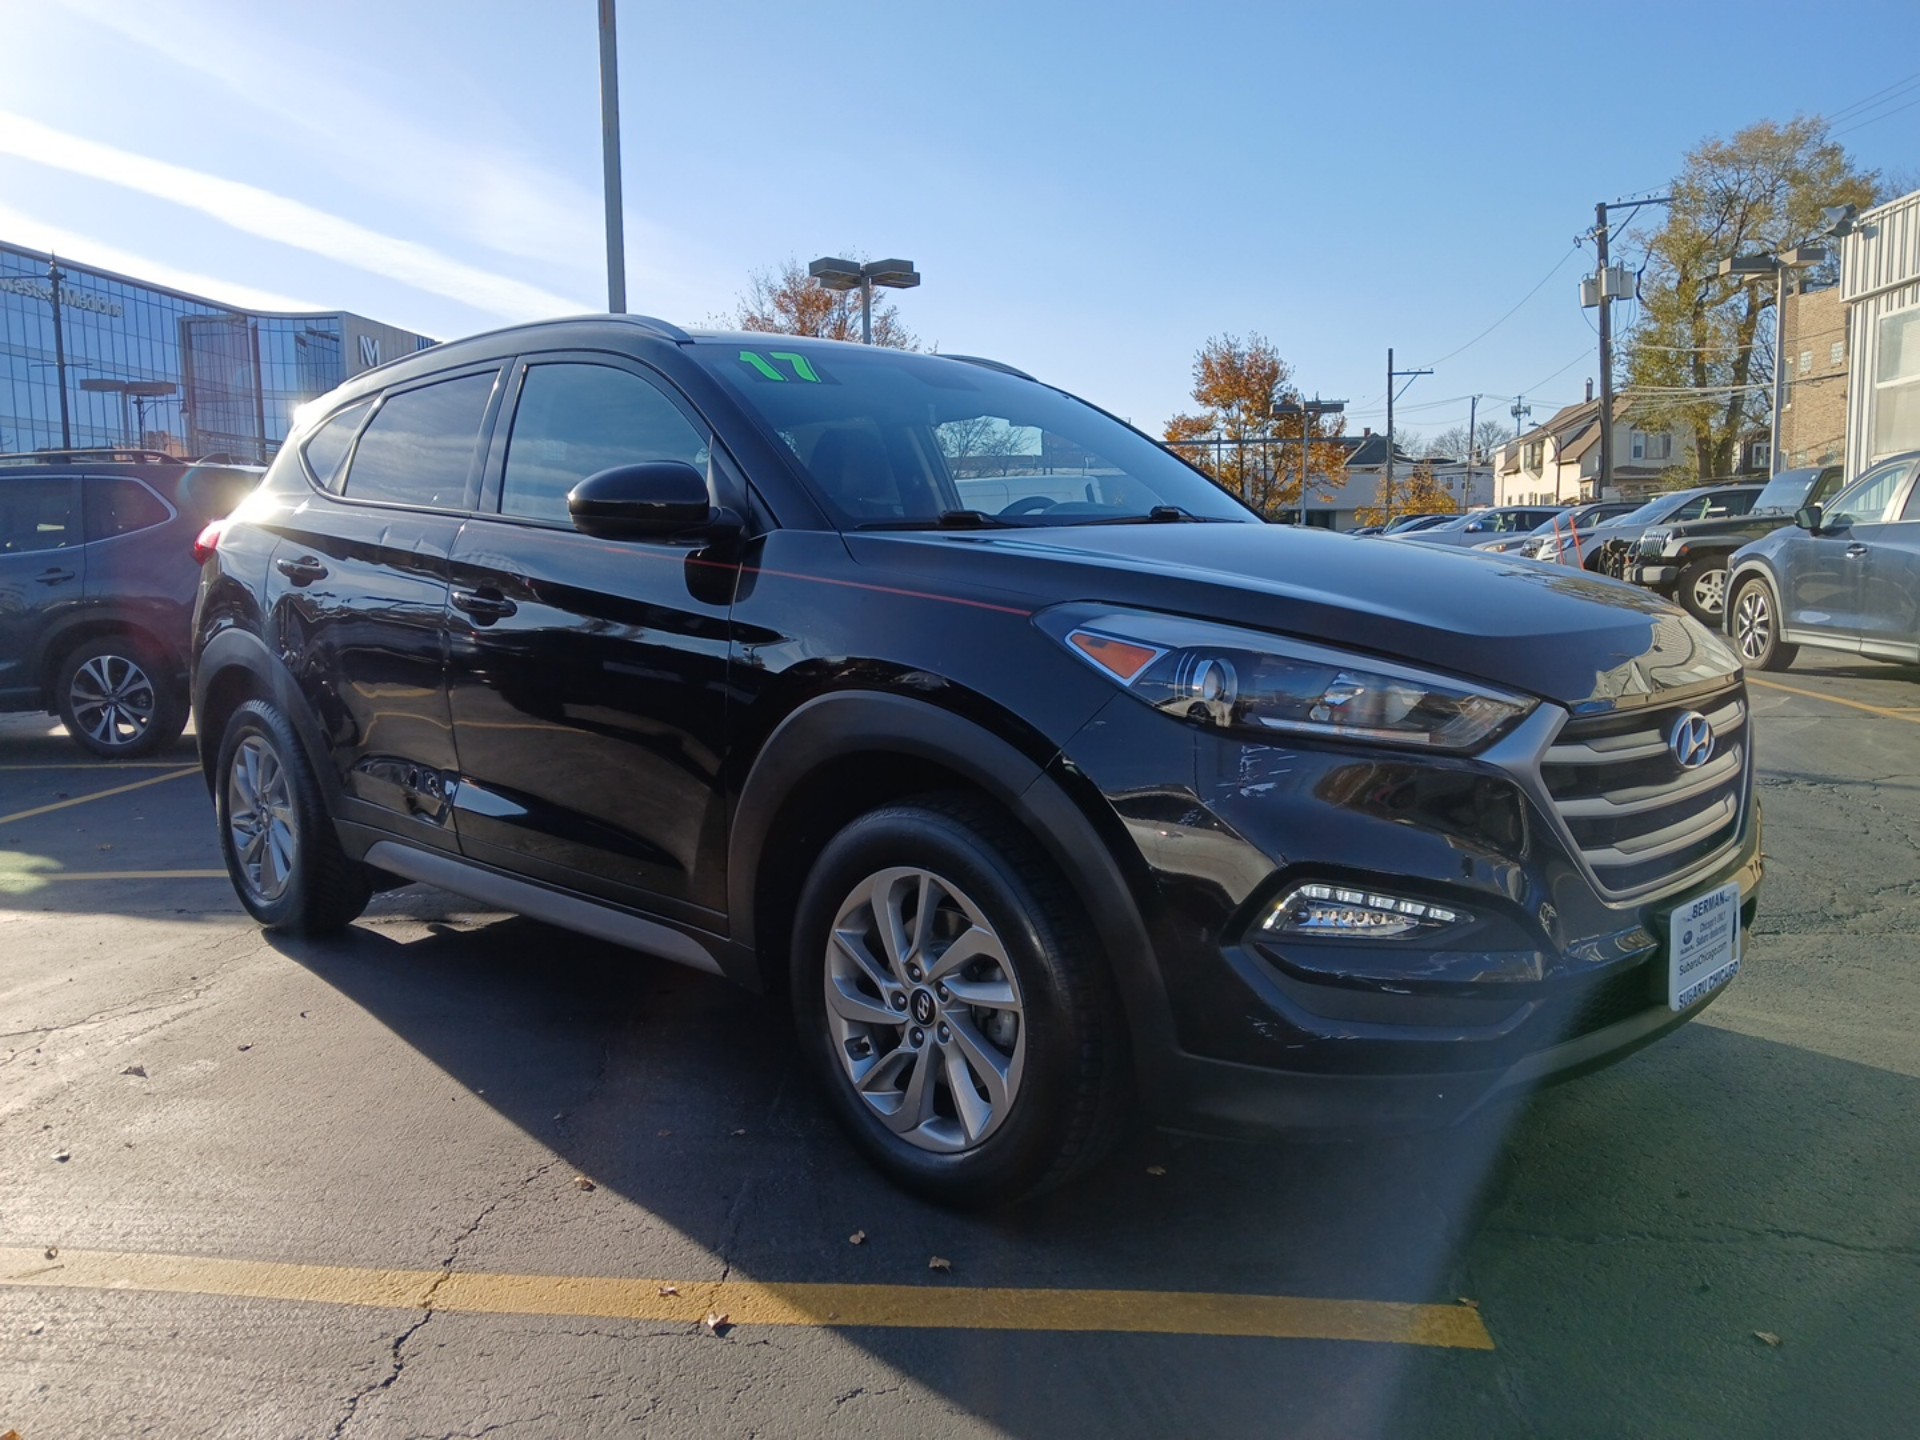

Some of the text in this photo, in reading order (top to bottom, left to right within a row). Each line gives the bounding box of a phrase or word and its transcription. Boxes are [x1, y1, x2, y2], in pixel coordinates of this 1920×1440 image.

[64, 287, 123, 318] Medicine
[739, 351, 821, 383] 17
[1692, 890, 1725, 919] BERMAN
[1679, 960, 1738, 1009] SUBARU CHICAGO
